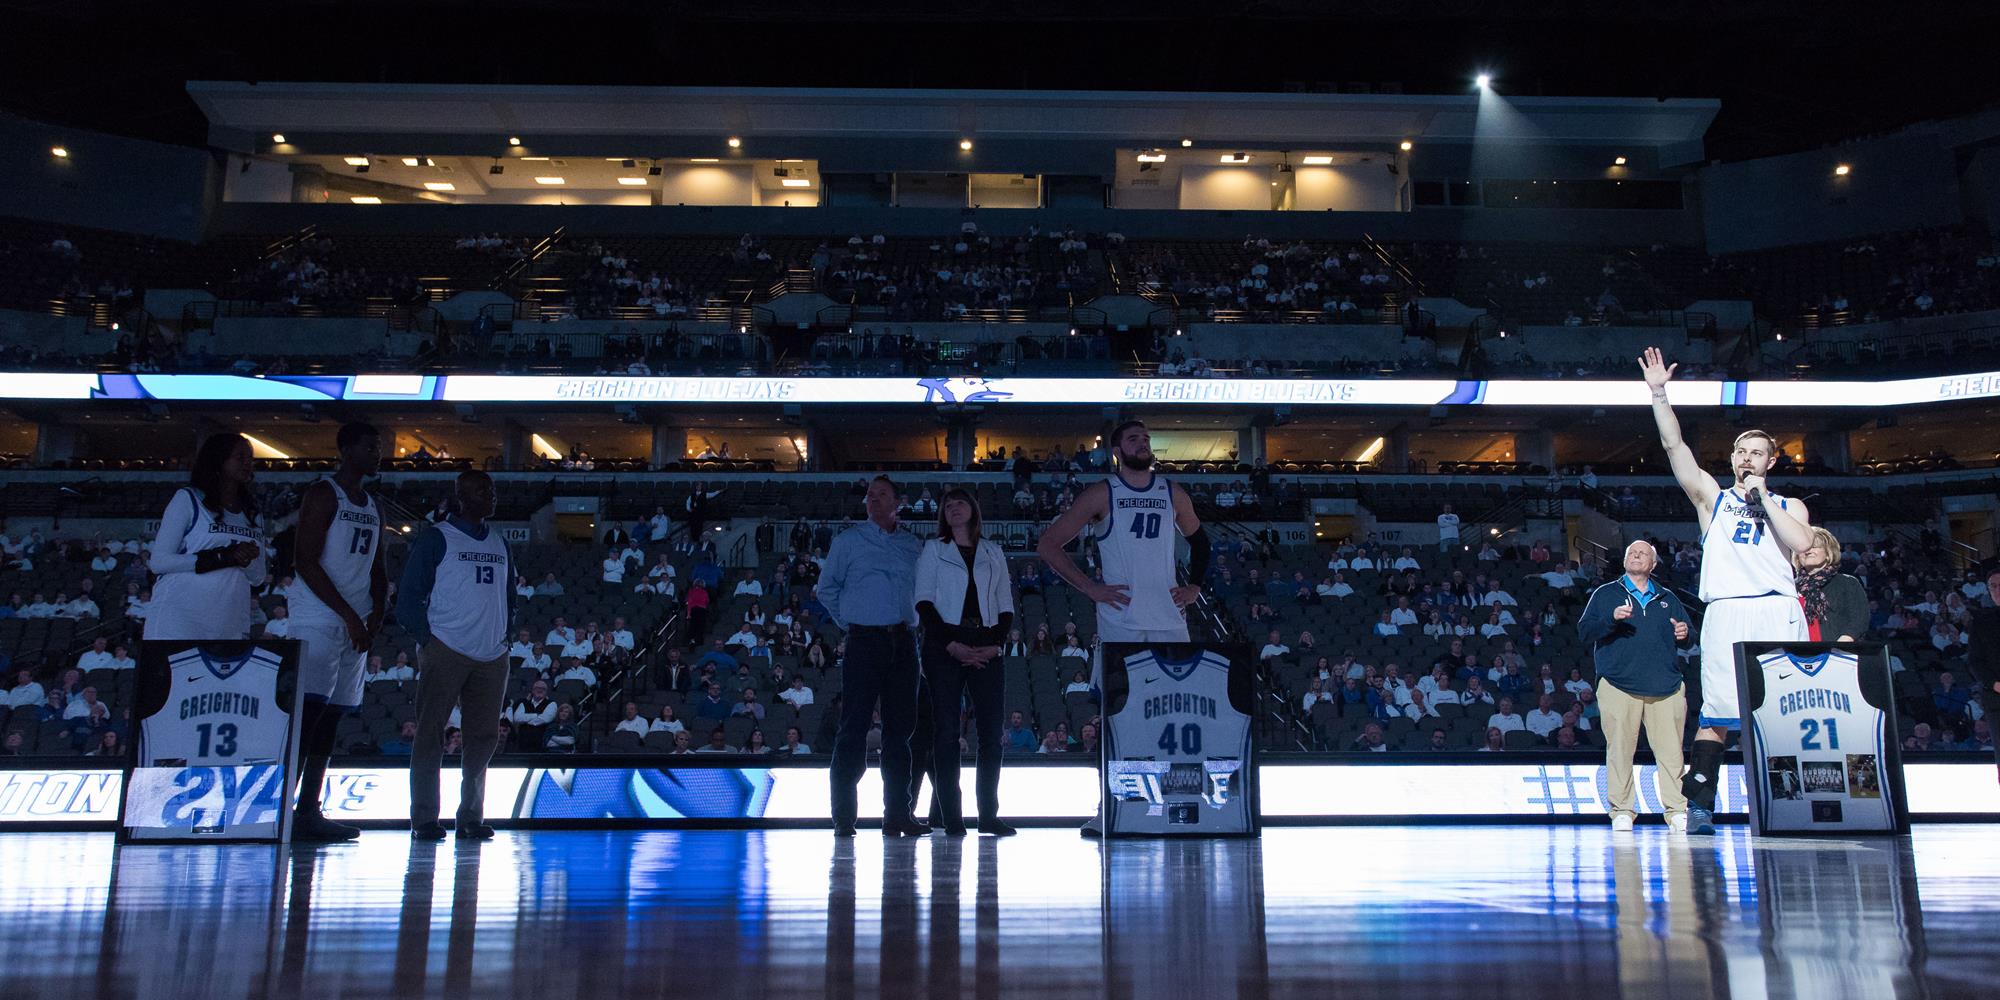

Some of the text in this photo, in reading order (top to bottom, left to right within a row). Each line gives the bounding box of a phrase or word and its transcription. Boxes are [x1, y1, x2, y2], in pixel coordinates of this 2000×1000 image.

[555, 381, 797, 400] CREIGHTON BLUEJAYS
[1122, 383, 1357, 402] CREIGHTON BLUEJAYS
[1117, 498, 1167, 510] CREIGHTON
[506, 529, 526, 540] 104
[1129, 512, 1161, 539] 40
[1286, 530, 1306, 541] 106
[1381, 530, 1401, 541] 107
[1732, 520, 1762, 546] 21
[350, 527, 373, 555] 13
[458, 552, 505, 565] CREIGHTON
[475, 565, 495, 585] 13
[179, 692, 260, 721] CREIGHTON
[1144, 692, 1217, 721] CREIGHTON
[1779, 687, 1852, 716] CREIGHTON
[196, 722, 238, 758] 13
[1158, 723, 1202, 756] 40
[1800, 717, 1840, 751] 21
